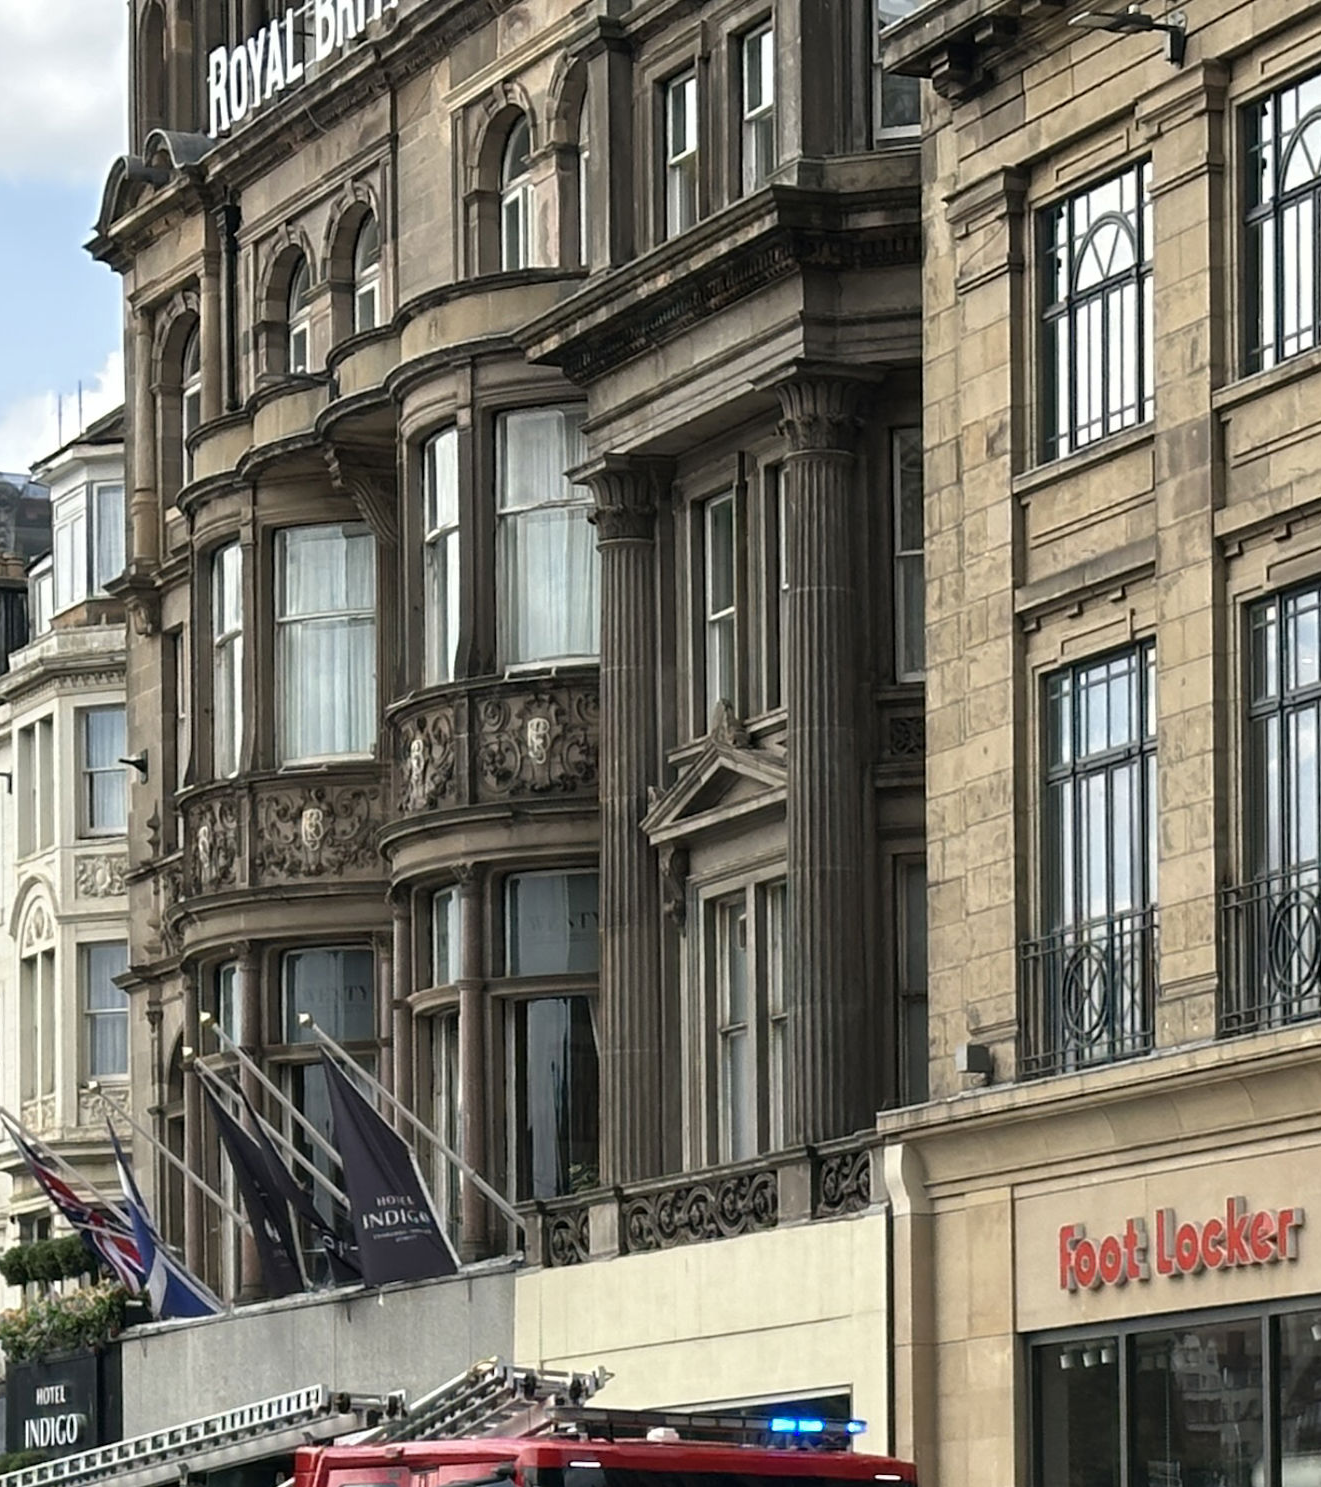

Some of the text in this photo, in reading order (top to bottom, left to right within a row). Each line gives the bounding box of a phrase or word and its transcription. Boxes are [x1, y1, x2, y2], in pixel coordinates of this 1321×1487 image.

[208, 8, 304, 139] ROYAL
[1059, 1196, 1303, 1290] Foot Locker
[36, 1384, 66, 1405] HOTEL
[24, 1413, 78, 1449] INDIGO
